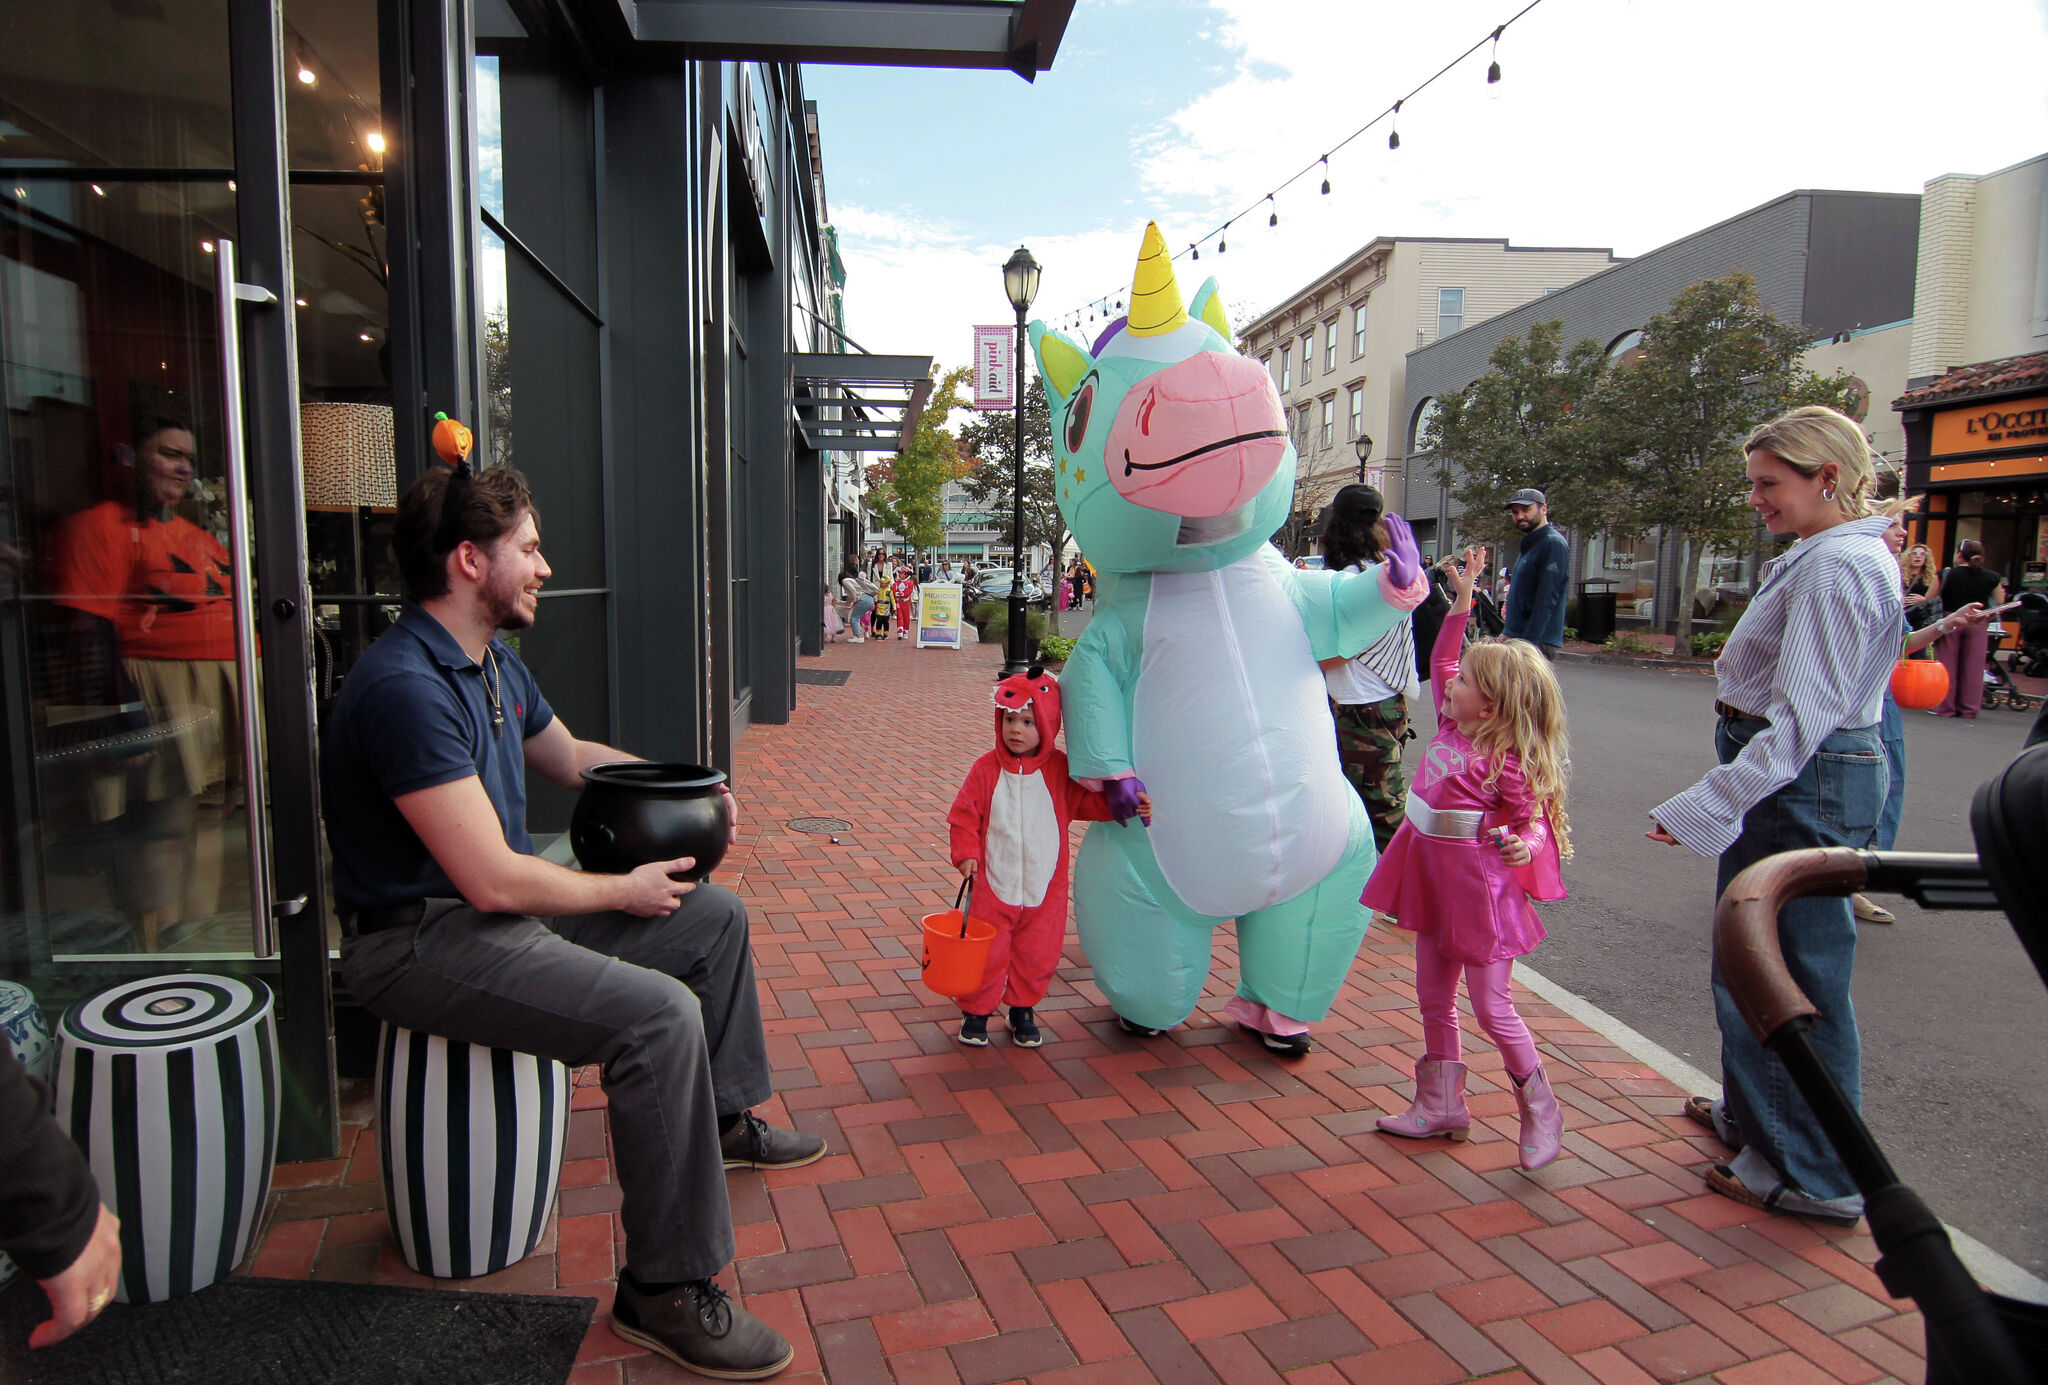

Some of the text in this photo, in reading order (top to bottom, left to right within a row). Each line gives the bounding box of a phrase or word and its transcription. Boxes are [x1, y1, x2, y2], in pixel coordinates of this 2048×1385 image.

[984, 342, 1003, 393] pink aid
[1611, 551, 1627, 561] Bring
